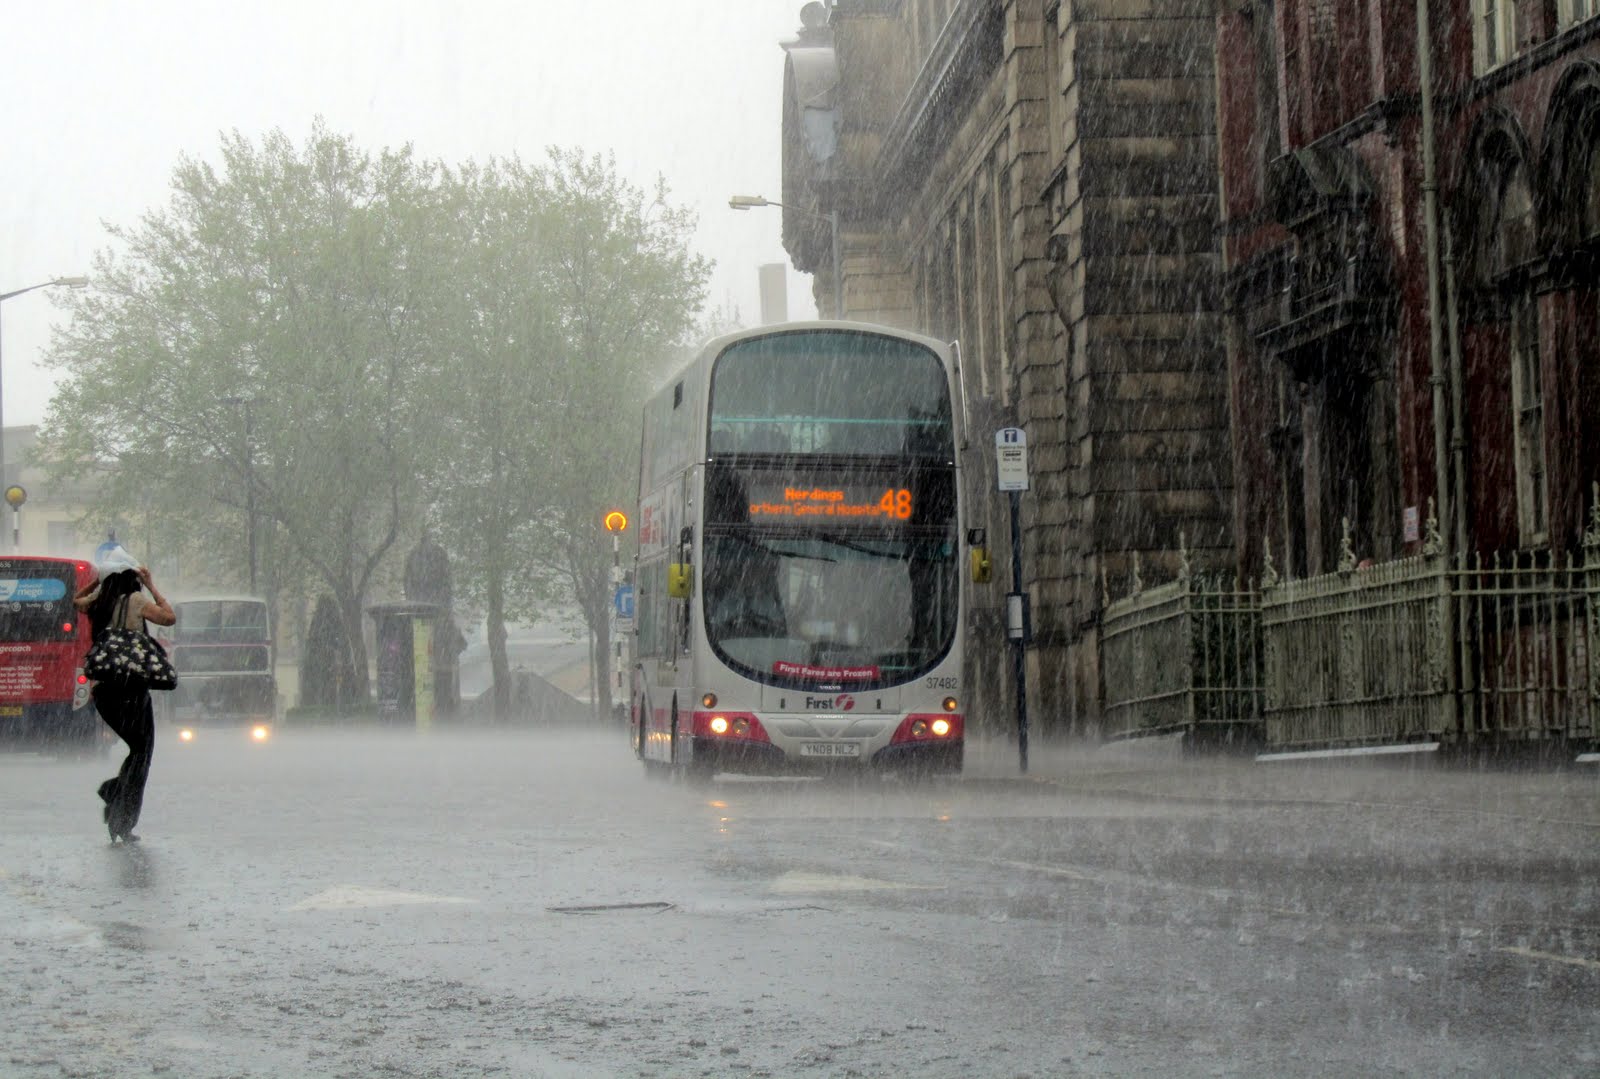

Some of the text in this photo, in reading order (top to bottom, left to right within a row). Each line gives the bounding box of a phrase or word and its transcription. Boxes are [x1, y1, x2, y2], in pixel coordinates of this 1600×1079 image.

[785, 487, 912, 519] Herdings 48
[793, 503, 834, 516] General
[779, 663, 800, 674] First
[801, 667, 825, 677] Fares
[843, 669, 872, 678] Frozen
[926, 677, 957, 689] 37482
[806, 697, 833, 709] First
[834, 744, 855, 755] NLZ
